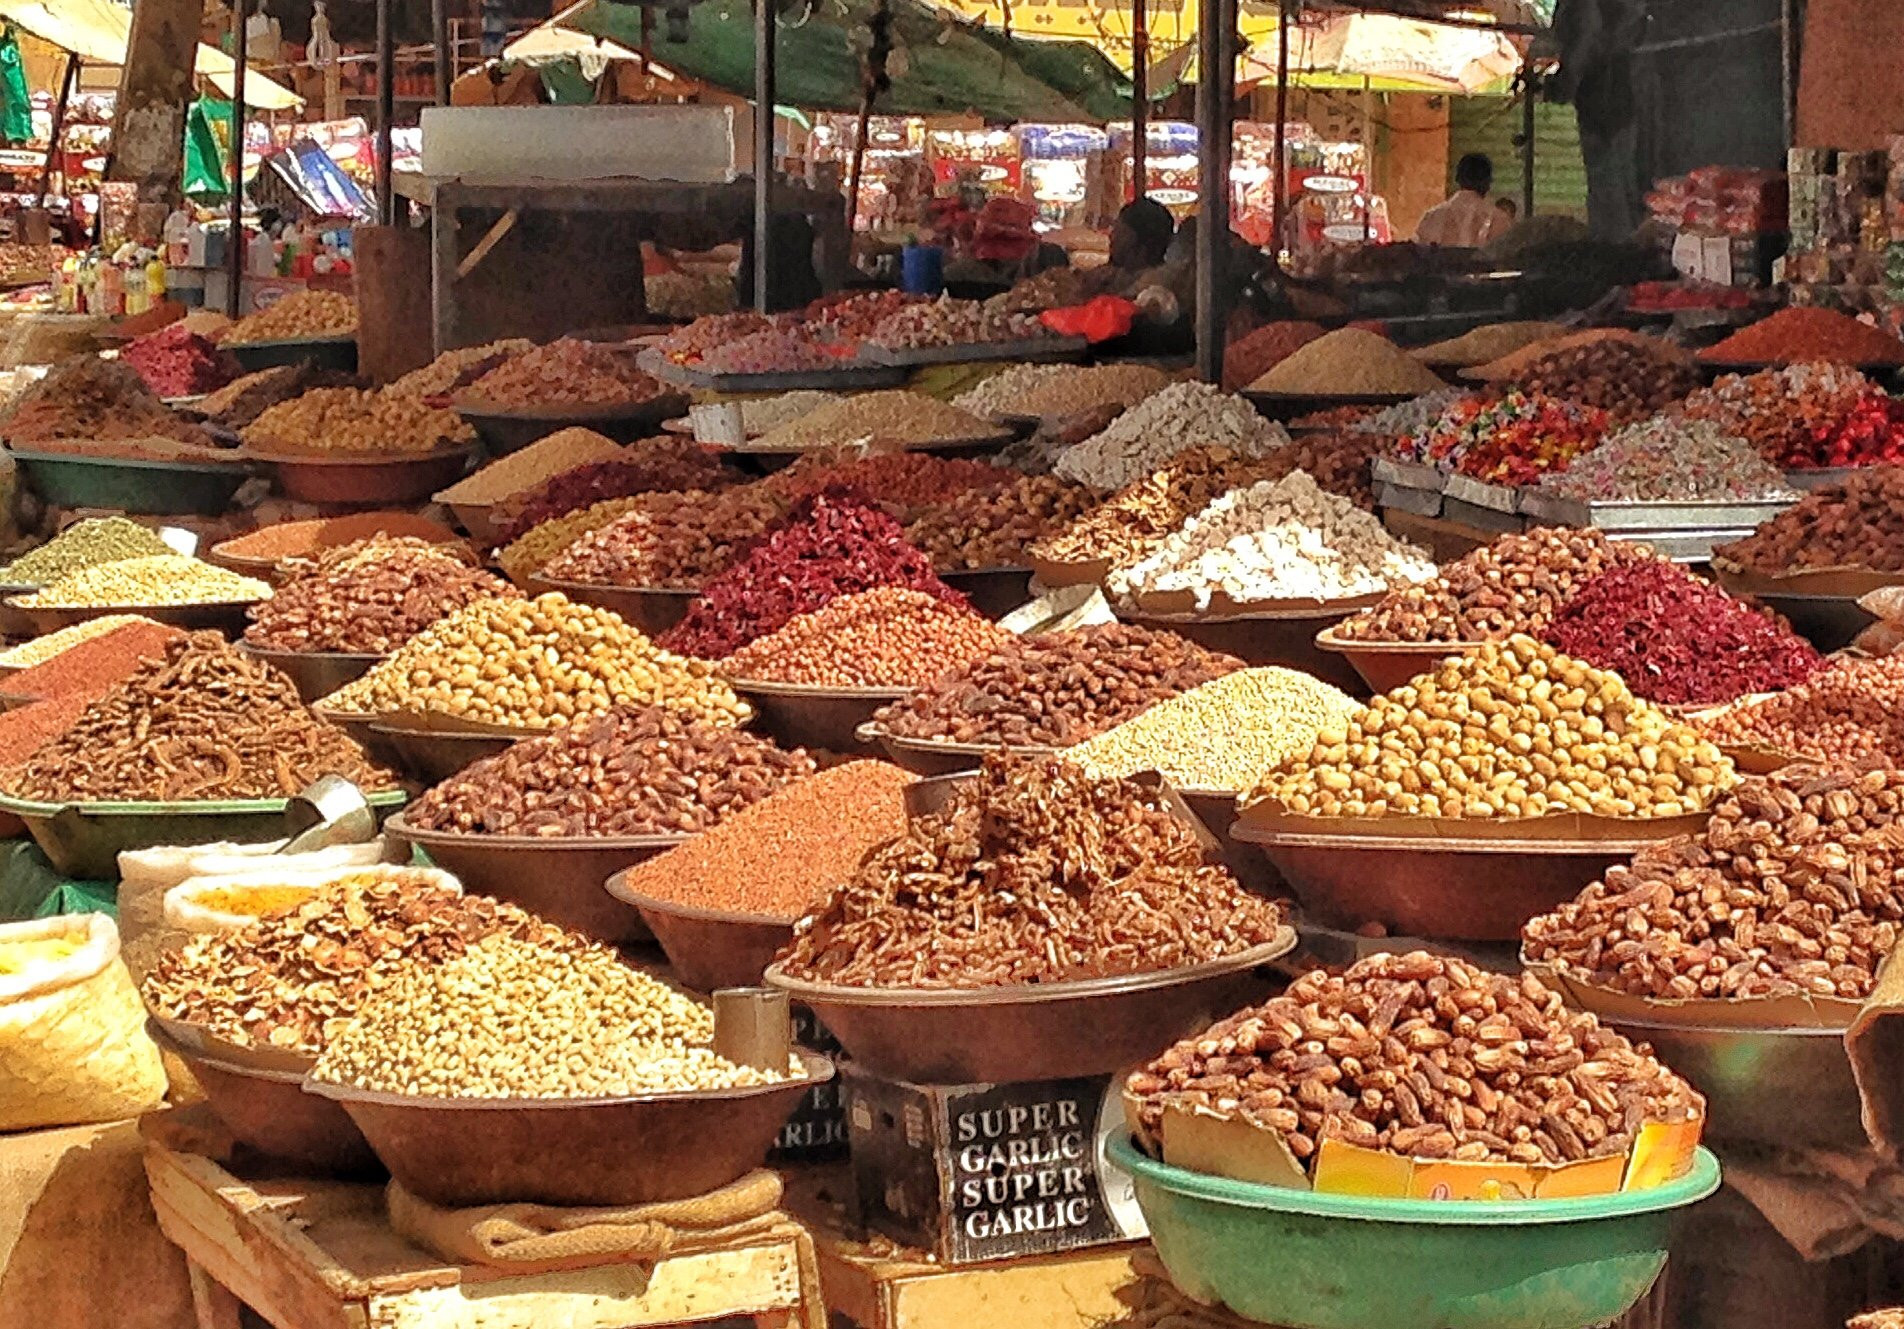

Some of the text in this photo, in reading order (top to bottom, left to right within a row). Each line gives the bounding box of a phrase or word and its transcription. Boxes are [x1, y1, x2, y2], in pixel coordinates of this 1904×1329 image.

[958, 1100, 1079, 1141] SUPER
[961, 1131, 1083, 1173] GARLIC
[963, 1166, 1086, 1207] SUPER
[966, 1197, 1089, 1238] GARLIC
